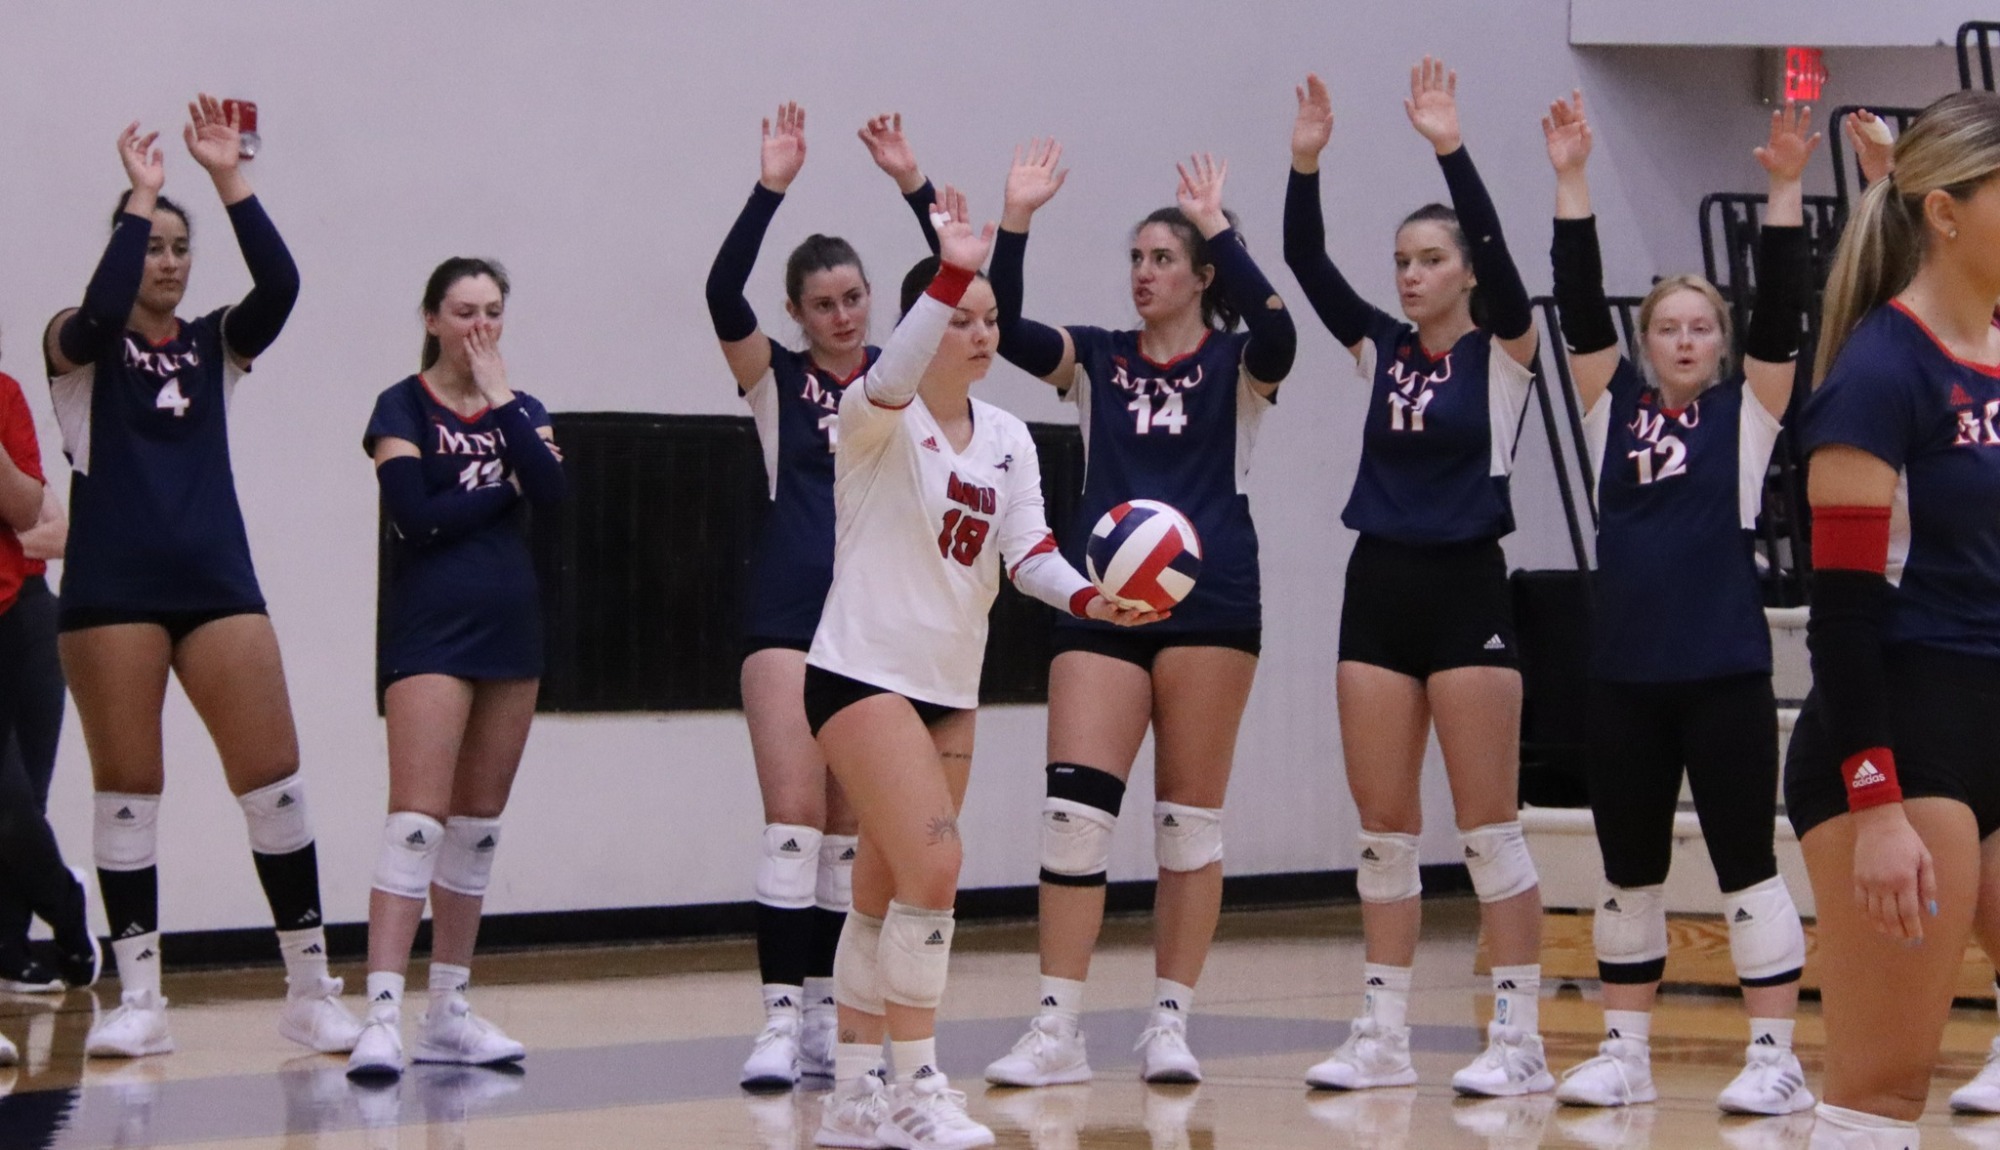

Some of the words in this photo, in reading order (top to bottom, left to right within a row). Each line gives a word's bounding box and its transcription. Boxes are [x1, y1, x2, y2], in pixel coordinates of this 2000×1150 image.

[156, 377, 190, 417] 4
[1127, 391, 1188, 434] 14
[1387, 389, 1434, 431] 11
[1627, 434, 1687, 485] 12
[938, 508, 990, 567] 18
[1852, 773, 1886, 788] adidas
